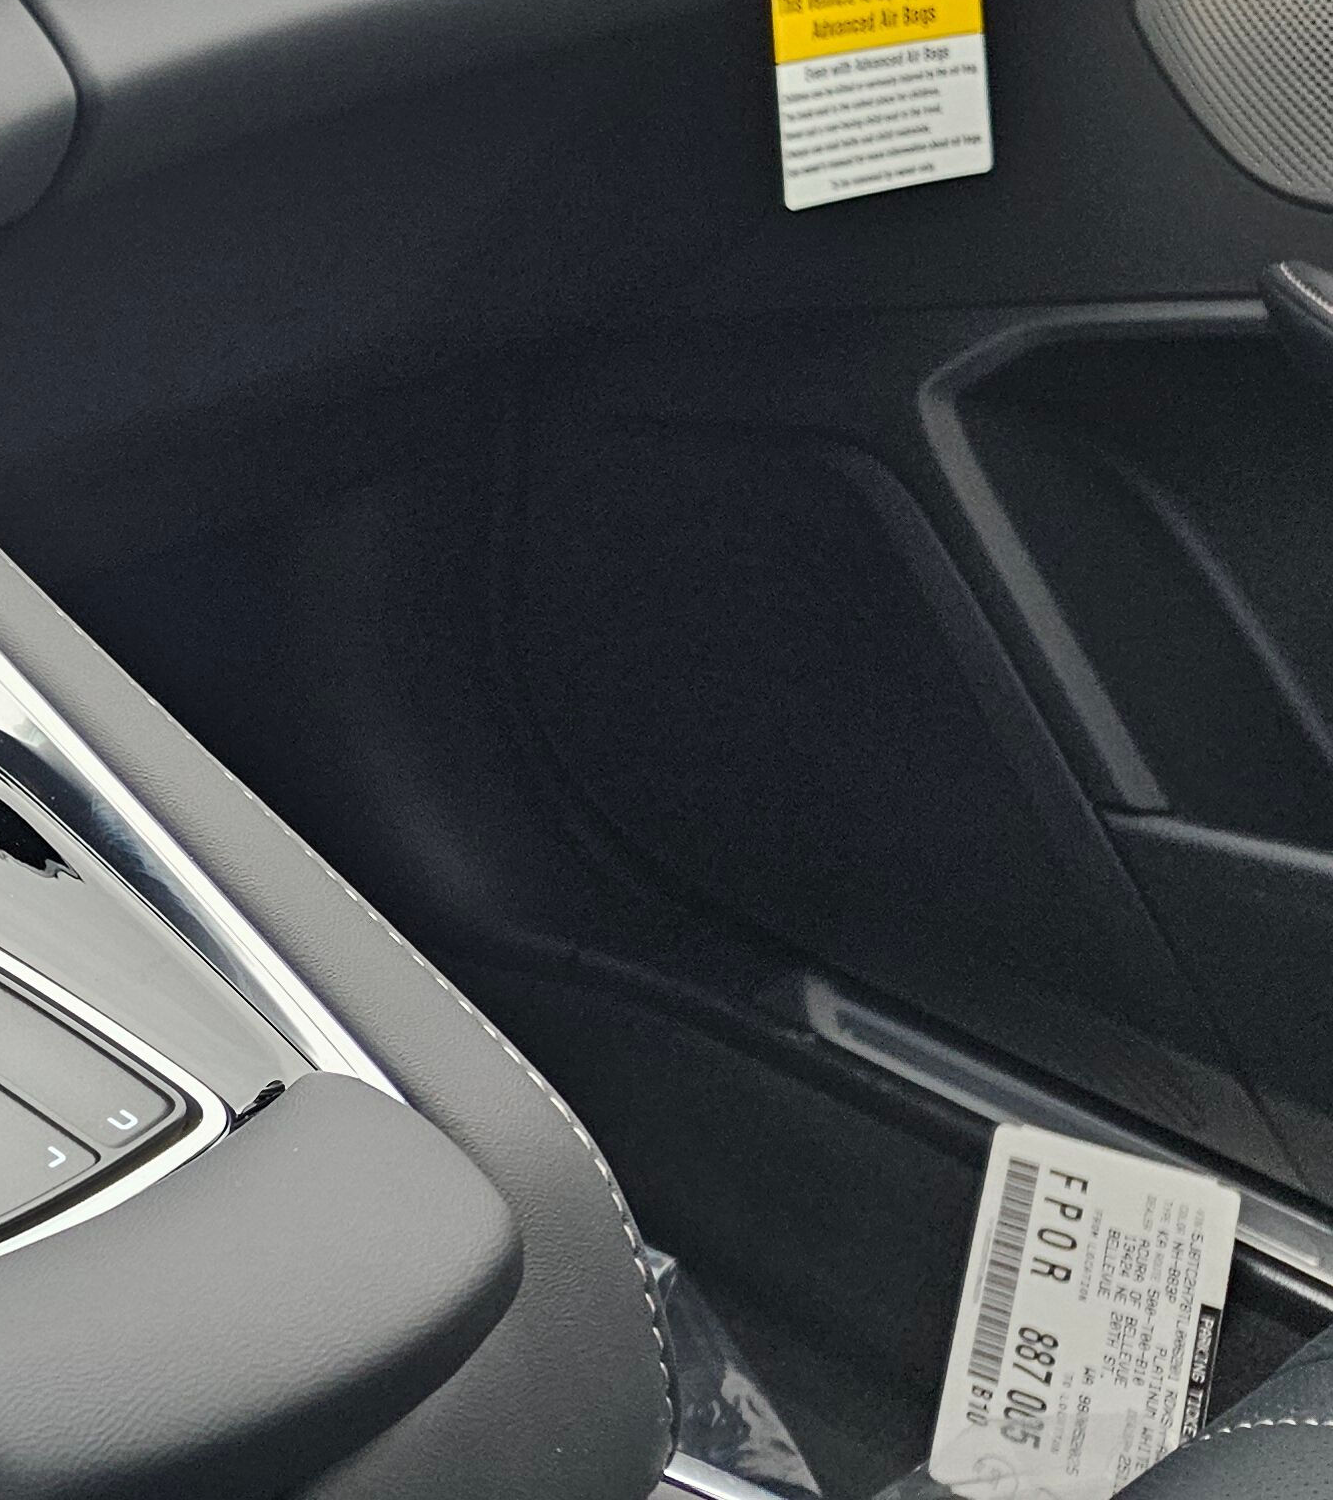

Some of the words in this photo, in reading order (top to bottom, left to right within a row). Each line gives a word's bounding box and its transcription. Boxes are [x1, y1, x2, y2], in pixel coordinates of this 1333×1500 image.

[812, 12, 875, 40] Advanced
[902, 6, 936, 27] Bags
[1096, 1228, 1121, 1300] BELLEVUE
[1117, 1234, 1137, 1279] 13424
[1132, 1237, 1151, 1284] ACURA
[1113, 1284, 1128, 1305] NE
[1127, 1289, 1142, 1310] OF
[1009, 1324, 1060, 1388] 887
[1114, 1315, 1138, 1388] BELLEVUE
[964, 1384, 994, 1428] B10
[1143, 1346, 1167, 1420] PLATINUM
[1181, 1388, 1203, 1440] TICKE
